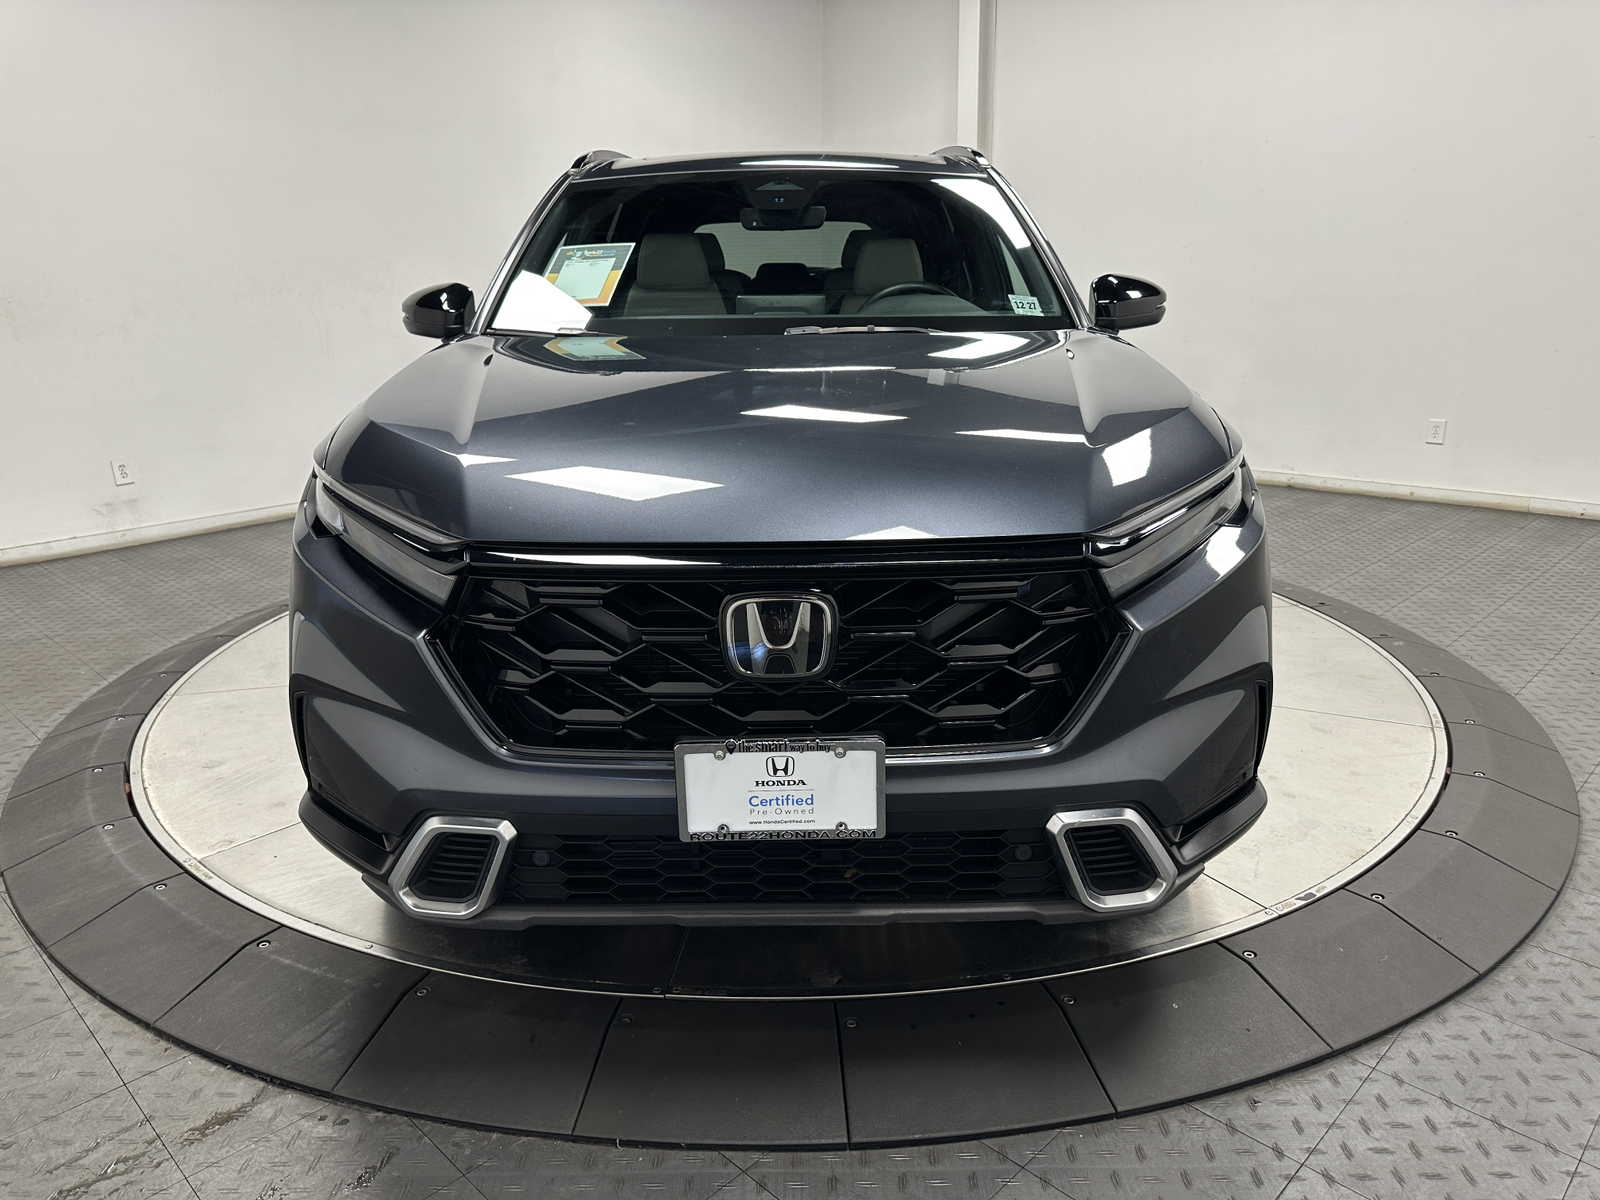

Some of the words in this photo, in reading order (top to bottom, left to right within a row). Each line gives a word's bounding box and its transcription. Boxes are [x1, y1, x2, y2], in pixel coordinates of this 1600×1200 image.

[1014, 301, 1026, 309] 12
[1027, 302, 1036, 310] 27
[755, 739, 789, 752] smart
[790, 744, 806, 753] way
[807, 741, 815, 751] to
[816, 739, 831, 753] buy
[749, 794, 814, 806] Certified
[749, 807, 814, 815] Pre-Owned
[689, 829, 877, 841] ROUTE22HONDA.COM
